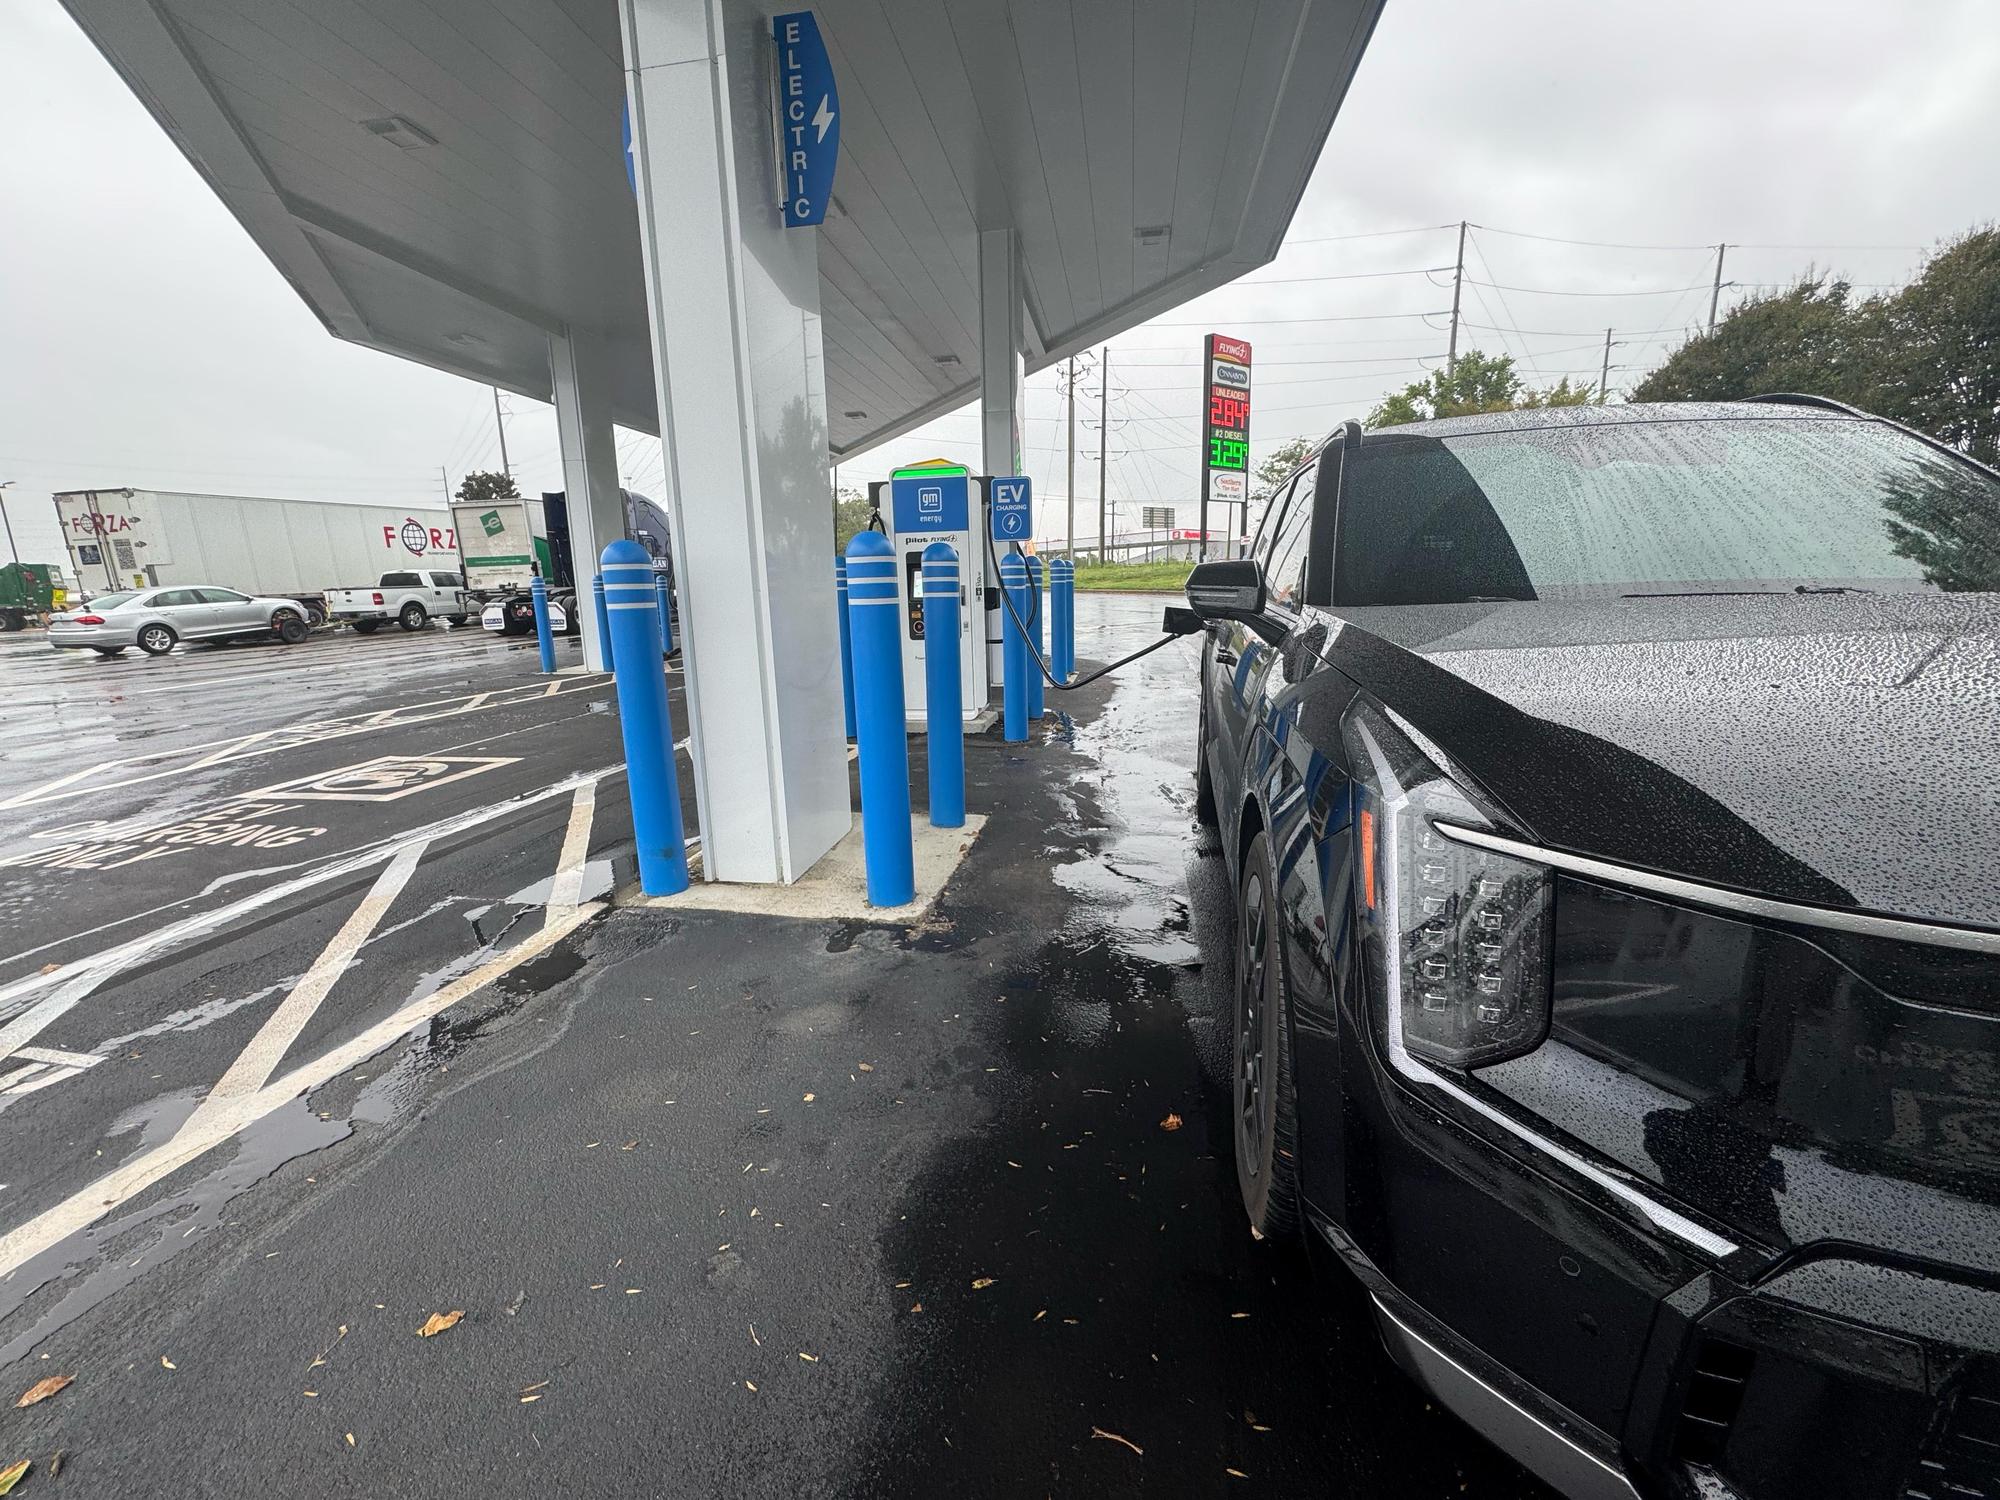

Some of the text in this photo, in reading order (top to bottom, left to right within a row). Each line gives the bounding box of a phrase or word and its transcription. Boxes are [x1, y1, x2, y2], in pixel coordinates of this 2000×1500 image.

[786, 22, 810, 218] ELECTRIC
[1219, 343, 1240, 356] FLYING
[1215, 387, 1245, 400] UNLEADED
[1215, 429, 1243, 440] #2 DIESEL
[997, 484, 1024, 503] EV
[72, 513, 131, 535] FORZA
[920, 515, 942, 523] energy
[383, 518, 457, 556] FORZ
